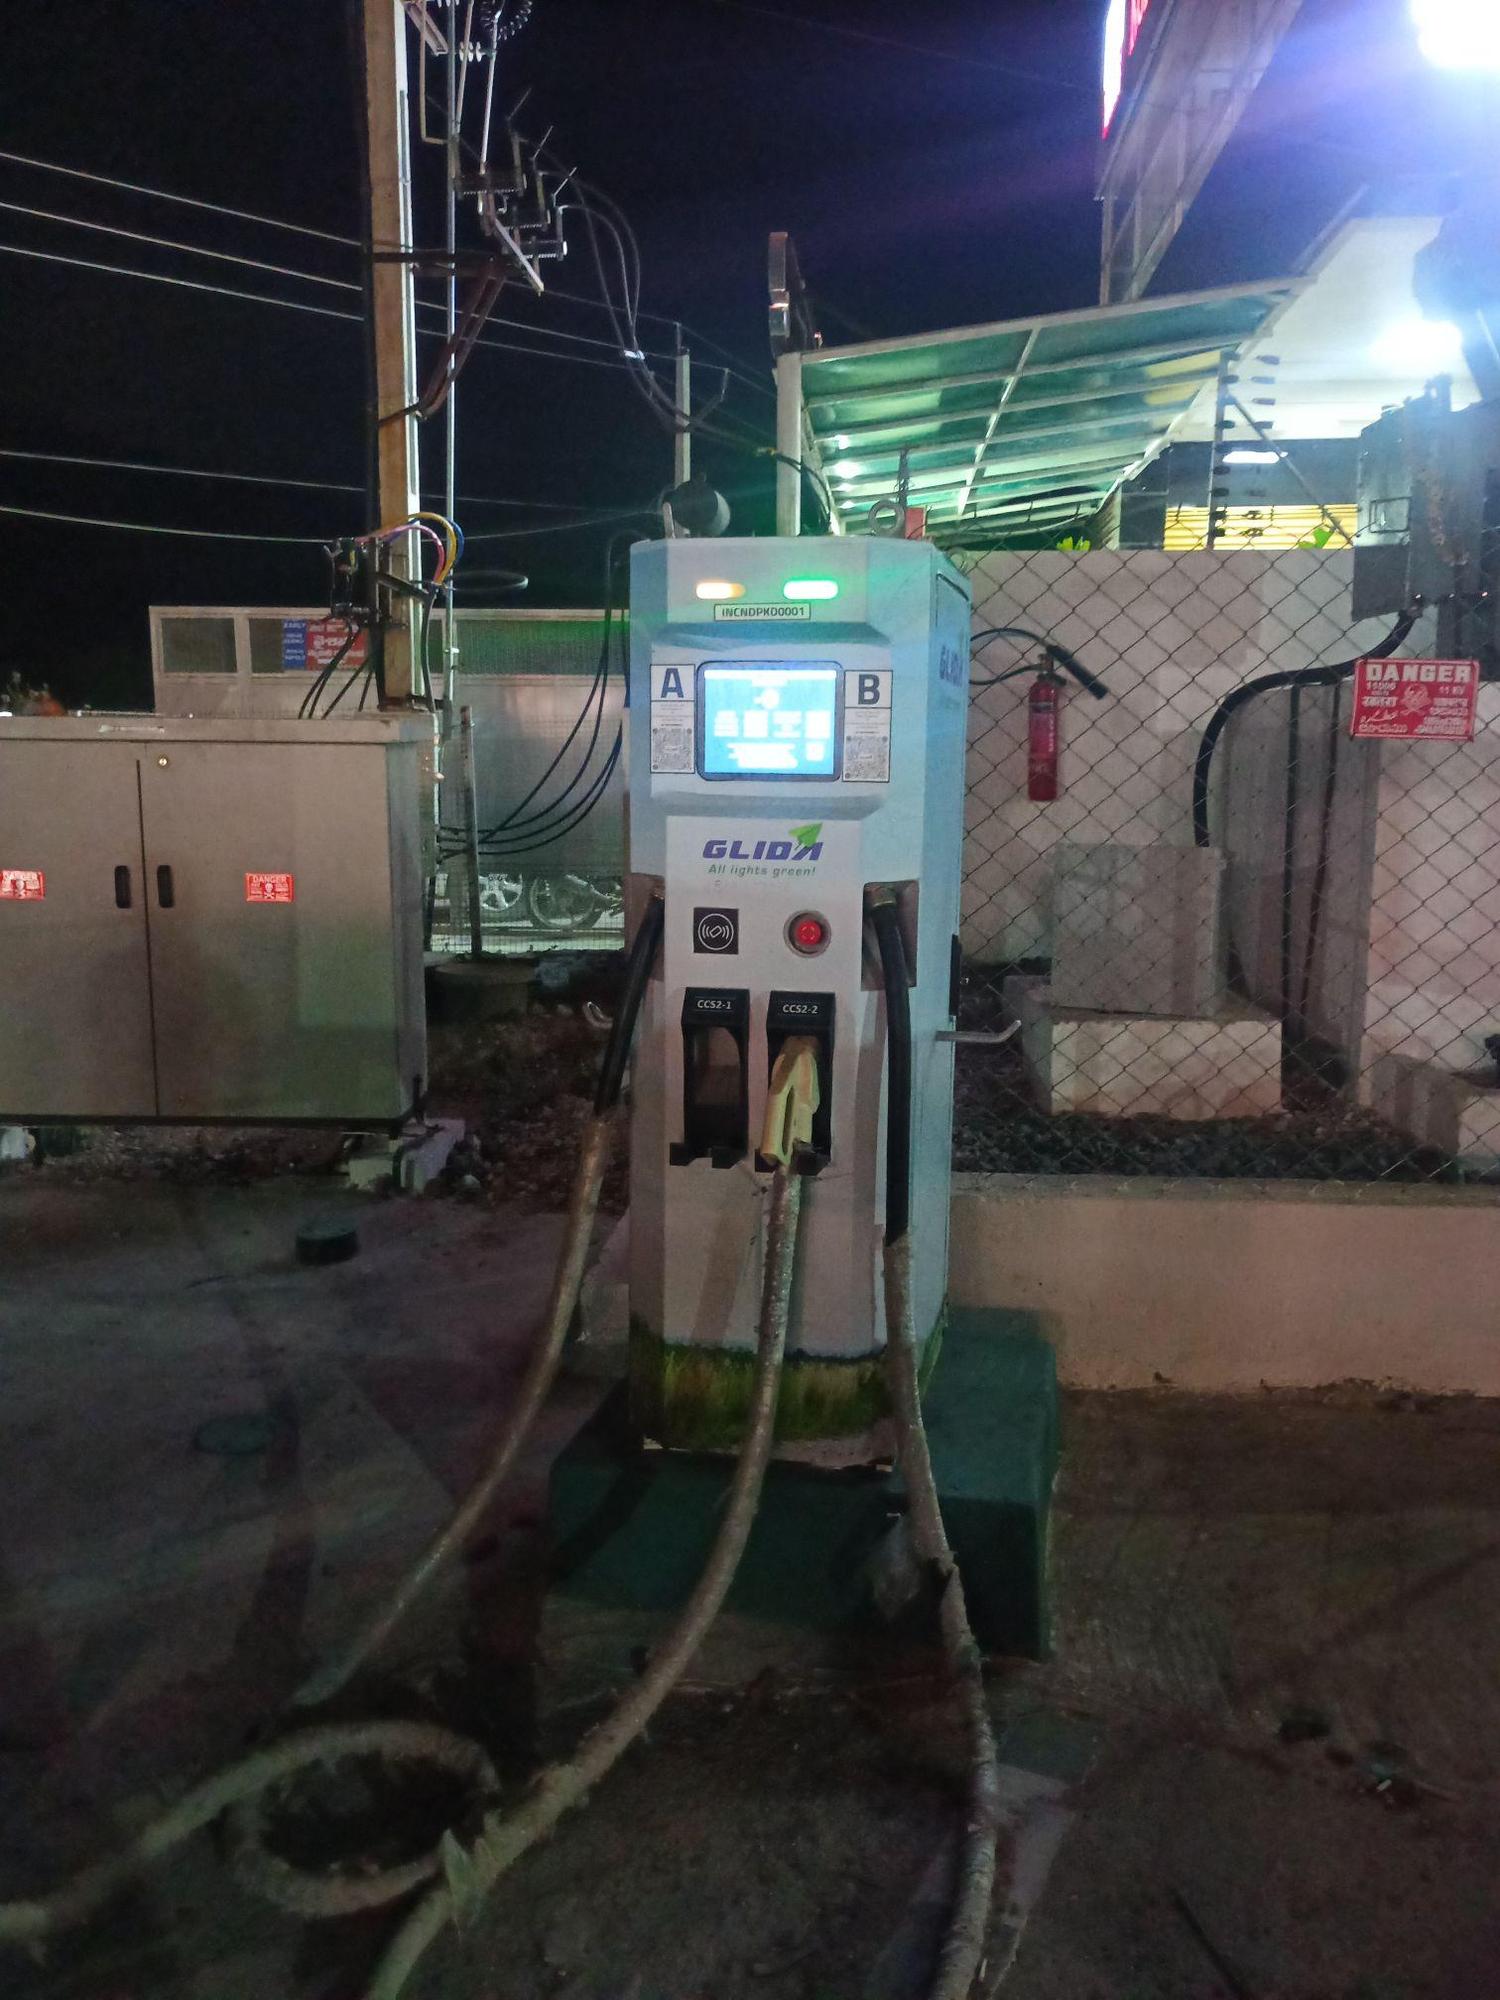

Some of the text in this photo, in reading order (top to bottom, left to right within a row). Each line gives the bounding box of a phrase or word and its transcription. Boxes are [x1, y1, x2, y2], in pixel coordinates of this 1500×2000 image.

[1366, 664, 1471, 682] DANGER
[660, 668, 684, 698] A
[857, 674, 880, 705] B
[703, 840, 823, 860] GLIDA
[709, 864, 816, 877] All lights green!
[697, 1000, 731, 1009] CCS2-1
[783, 1004, 818, 1013] CCS2-2
